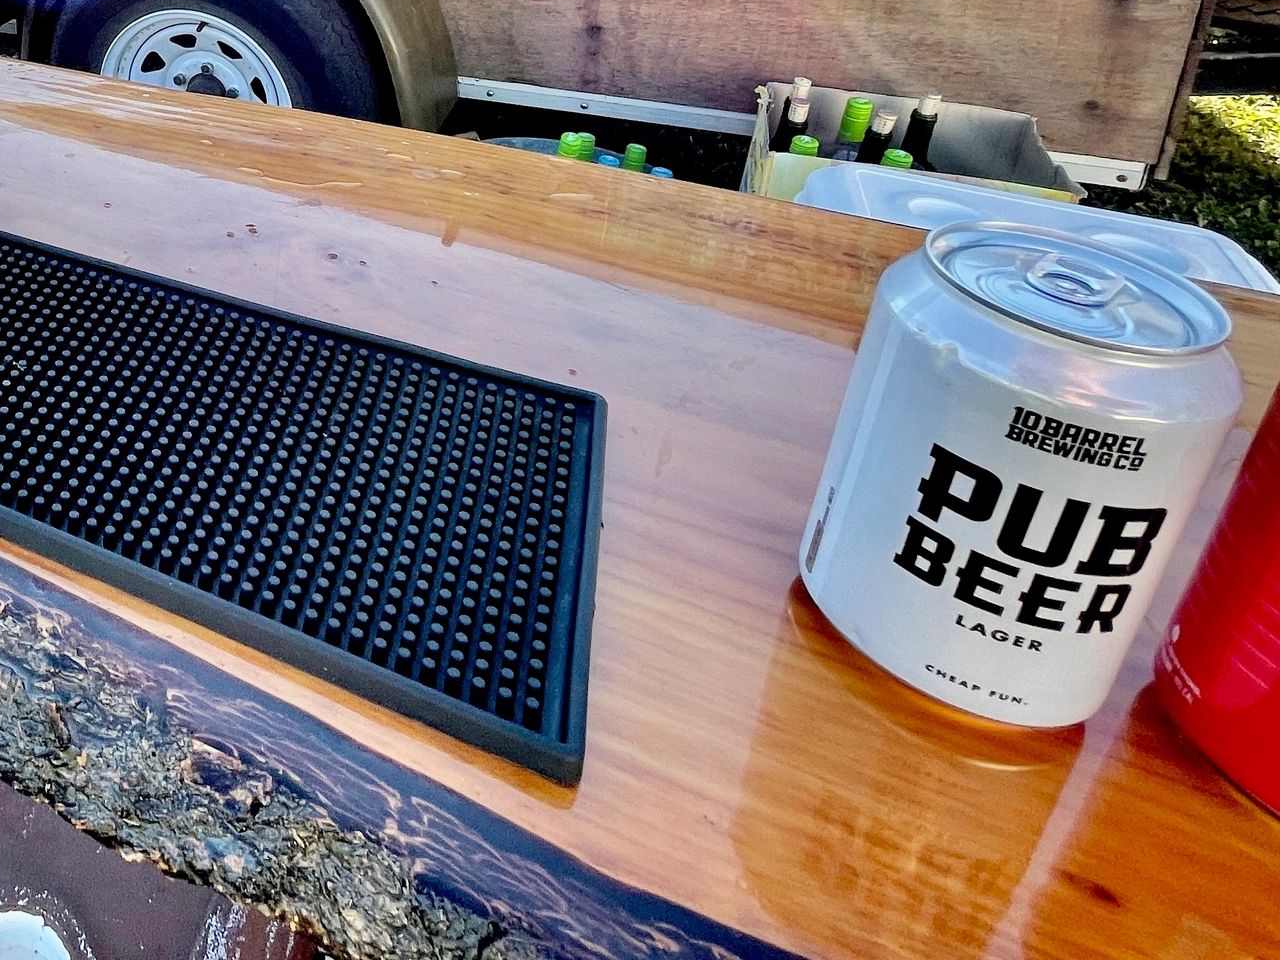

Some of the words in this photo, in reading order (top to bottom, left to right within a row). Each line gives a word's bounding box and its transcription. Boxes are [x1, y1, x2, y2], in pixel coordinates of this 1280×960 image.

[1004, 423, 1114, 467] BREWING
[917, 442, 1168, 578] PUB
[892, 514, 1132, 634] BEER
[955, 613, 1043, 652] LAGER
[925, 664, 981, 691] CHEAP
[988, 690, 1029, 706] FUN.
